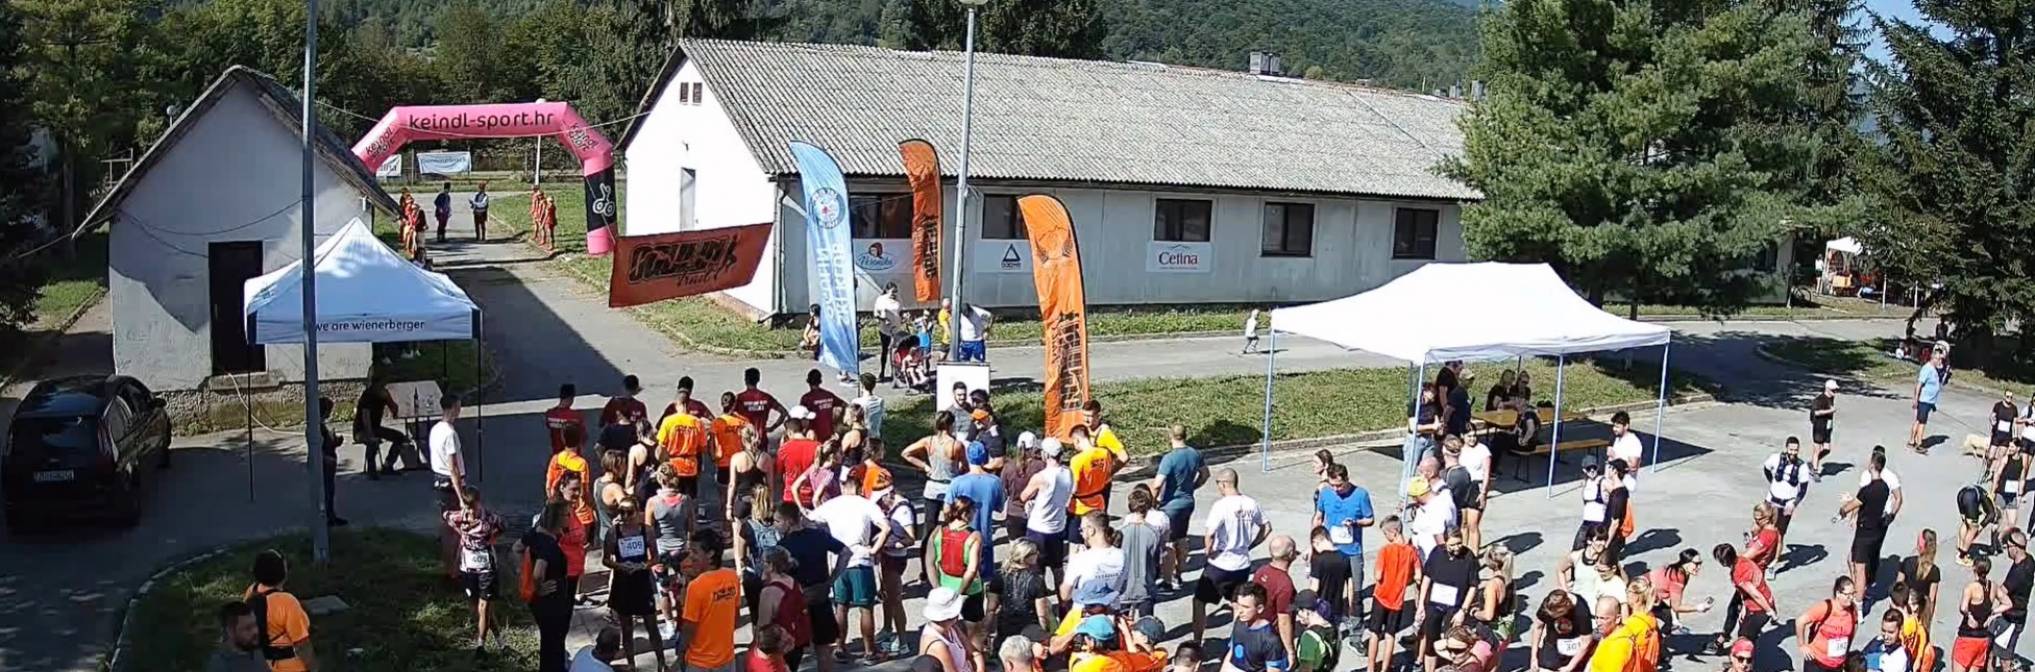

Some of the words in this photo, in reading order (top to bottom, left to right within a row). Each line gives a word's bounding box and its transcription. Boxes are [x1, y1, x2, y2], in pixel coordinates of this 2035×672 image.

[409, 111, 554, 130] keindl-sport.hr
[331, 322, 349, 332] are
[352, 319, 425, 332] wienerberger
